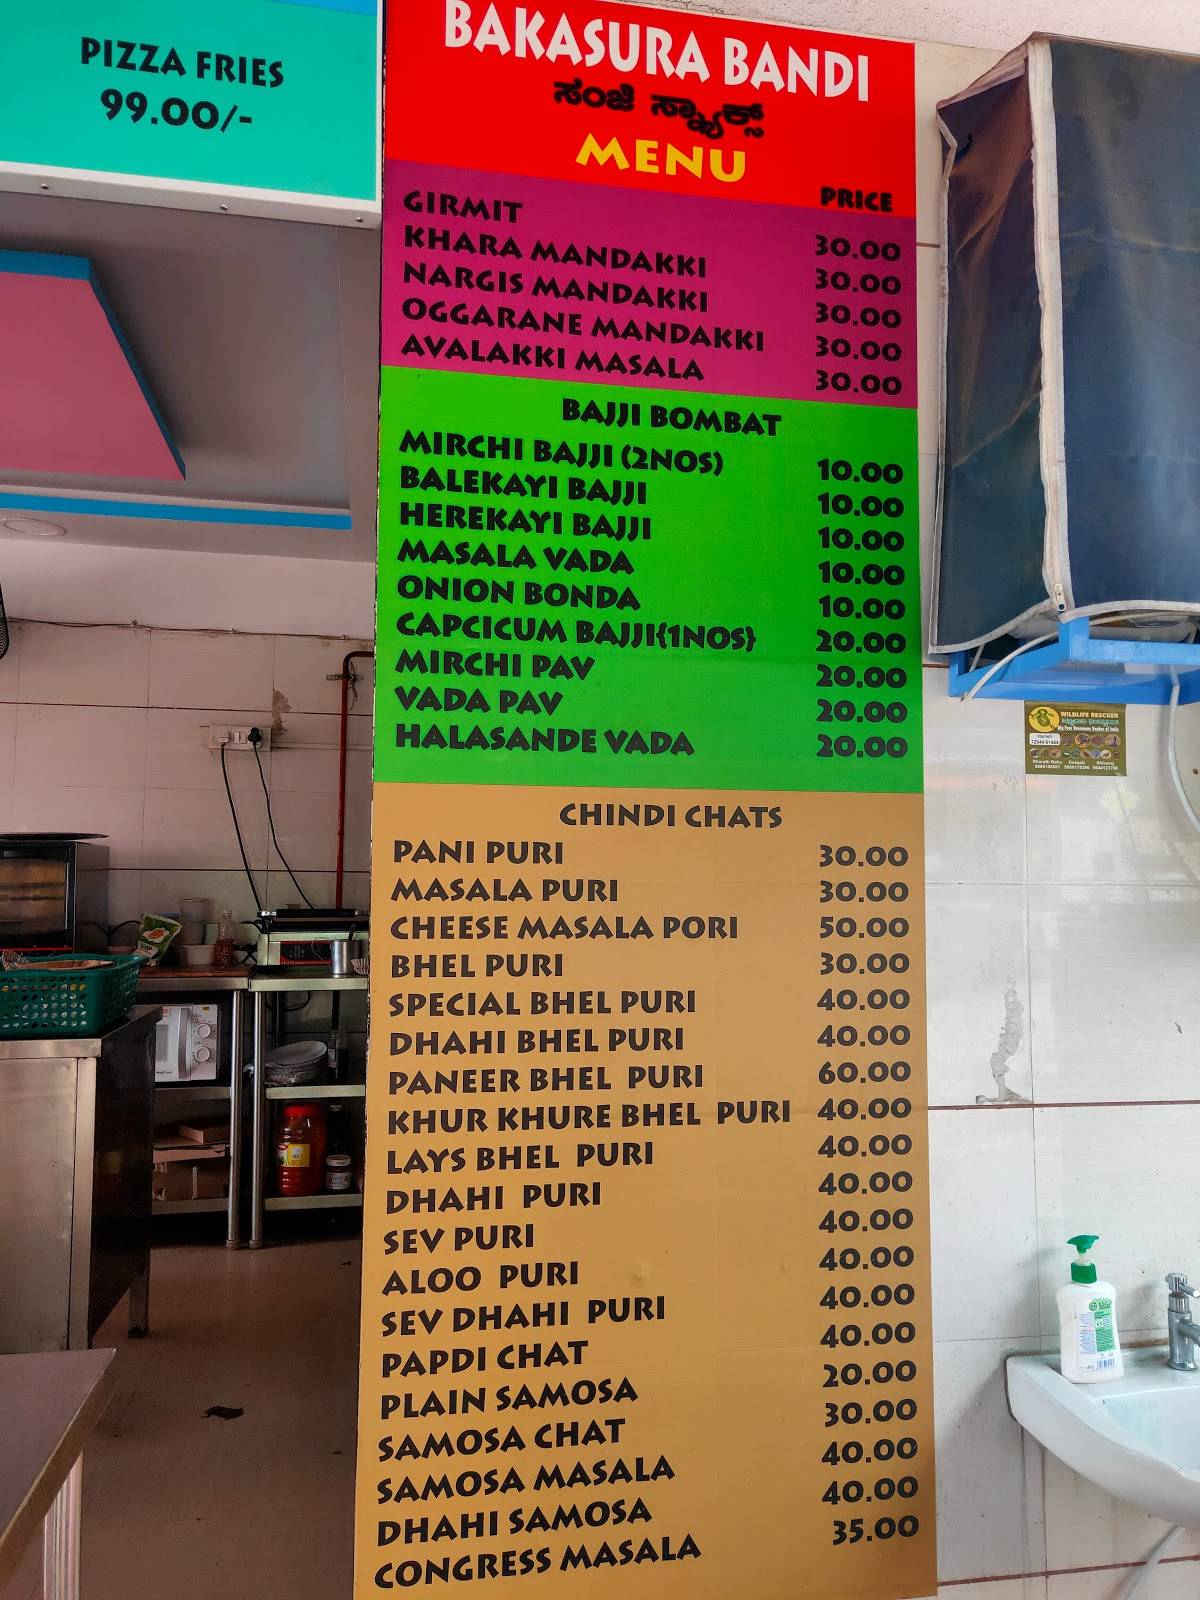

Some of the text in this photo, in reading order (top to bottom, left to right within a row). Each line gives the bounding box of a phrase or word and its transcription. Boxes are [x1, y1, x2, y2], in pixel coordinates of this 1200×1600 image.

[81, 36, 284, 89] PIZZA FRIES
[446, 0, 869, 102] BAKASURA BANDI
[100, 88, 253, 134] 99.00/-
[576, 134, 745, 182] MENU
[404, 191, 523, 223] GIRMIT
[820, 187, 893, 213] PRICE
[405, 225, 705, 278] KHARA MANDAKKI
[816, 235, 901, 262] 30.00
[404, 262, 707, 312] NARGIS MANDAKKI
[816, 268, 901, 295] 30.00
[403, 298, 763, 351] OGGARANE MANDAKKI
[816, 302, 902, 328] 30.00
[401, 335, 704, 380] AVALAKKI MASALA
[816, 336, 902, 362] 30.00
[816, 370, 902, 395] 30.00
[563, 399, 782, 436] BAJJI BOMBAT
[399, 430, 723, 476] MIRCHI BAJJI (2NOS)
[817, 458, 903, 484] 10.00
[401, 466, 646, 506] BALEKAYI BAJJI
[818, 492, 904, 518] 10.00
[401, 502, 650, 542] HEREKAYI BAJJI
[818, 527, 905, 552] 10.00
[397, 538, 634, 575] MASALA VADA
[818, 561, 905, 586] 10.00
[398, 575, 641, 610] ONION BONDA
[819, 595, 906, 620] 10.00
[397, 613, 567, 643] CAPCICUM
[816, 629, 907, 655] 20.00
[395, 649, 595, 680] MIRCHI PAV
[816, 664, 907, 688] 20.00
[395, 686, 563, 715] VADA PAV
[816, 699, 907, 723] 20.00
[396, 724, 695, 756] HALASANDE VADA
[817, 734, 907, 758] 20.00
[560, 804, 782, 828] CHINDI CHATS
[394, 840, 562, 864] PANI PURI
[820, 845, 908, 867] 30.00
[391, 878, 617, 902] MASALA PURI
[820, 881, 908, 902] 30.00
[391, 916, 737, 939] CHEESE MASALA PORI
[820, 917, 909, 938] 50.00
[392, 954, 562, 978] BHEL PURI
[821, 953, 909, 975] 30.00
[389, 991, 695, 1017] SPECIAL BHEL PURI
[817, 989, 910, 1010] 40.00
[391, 1028, 683, 1055] DHAHI BHEL PURI
[817, 1025, 910, 1047] 40.00
[390, 1065, 702, 1094] PANEER BHEL PURI
[819, 1061, 911, 1084] 60.00
[389, 1101, 789, 1134] KHUR KHURE BHEL PURI
[818, 1098, 911, 1120] 40.00
[388, 1142, 652, 1174] LAYS BHEL PURI
[818, 1135, 912, 1158] 40.00
[819, 1171, 912, 1195] 40.00
[387, 1182, 600, 1214] DHAHI PURI
[819, 1209, 913, 1233] 40.00
[384, 1224, 533, 1255] SEV PURI
[819, 1246, 914, 1271] 40.00
[382, 1262, 578, 1295] ALOO PURI
[820, 1284, 914, 1309] 40.00
[382, 1296, 664, 1336] SEV DHAHI PURI
[820, 1322, 915, 1348] 40.00
[383, 1341, 588, 1377] PAPDI CHAT
[823, 1360, 916, 1387] 20.00
[382, 1377, 638, 1419] PLAIN SAMOSA
[825, 1399, 917, 1427] 30.00
[379, 1418, 625, 1462] SAMOSA CHAT
[822, 1437, 918, 1465] 40.00
[378, 1455, 675, 1504] SAMOSA MASALA
[822, 1476, 918, 1505] 40.00
[378, 1497, 652, 1546] DHAHI SAMOSA
[833, 1515, 919, 1545] 35.00
[375, 1534, 701, 1588] CONGRESS MASALA
